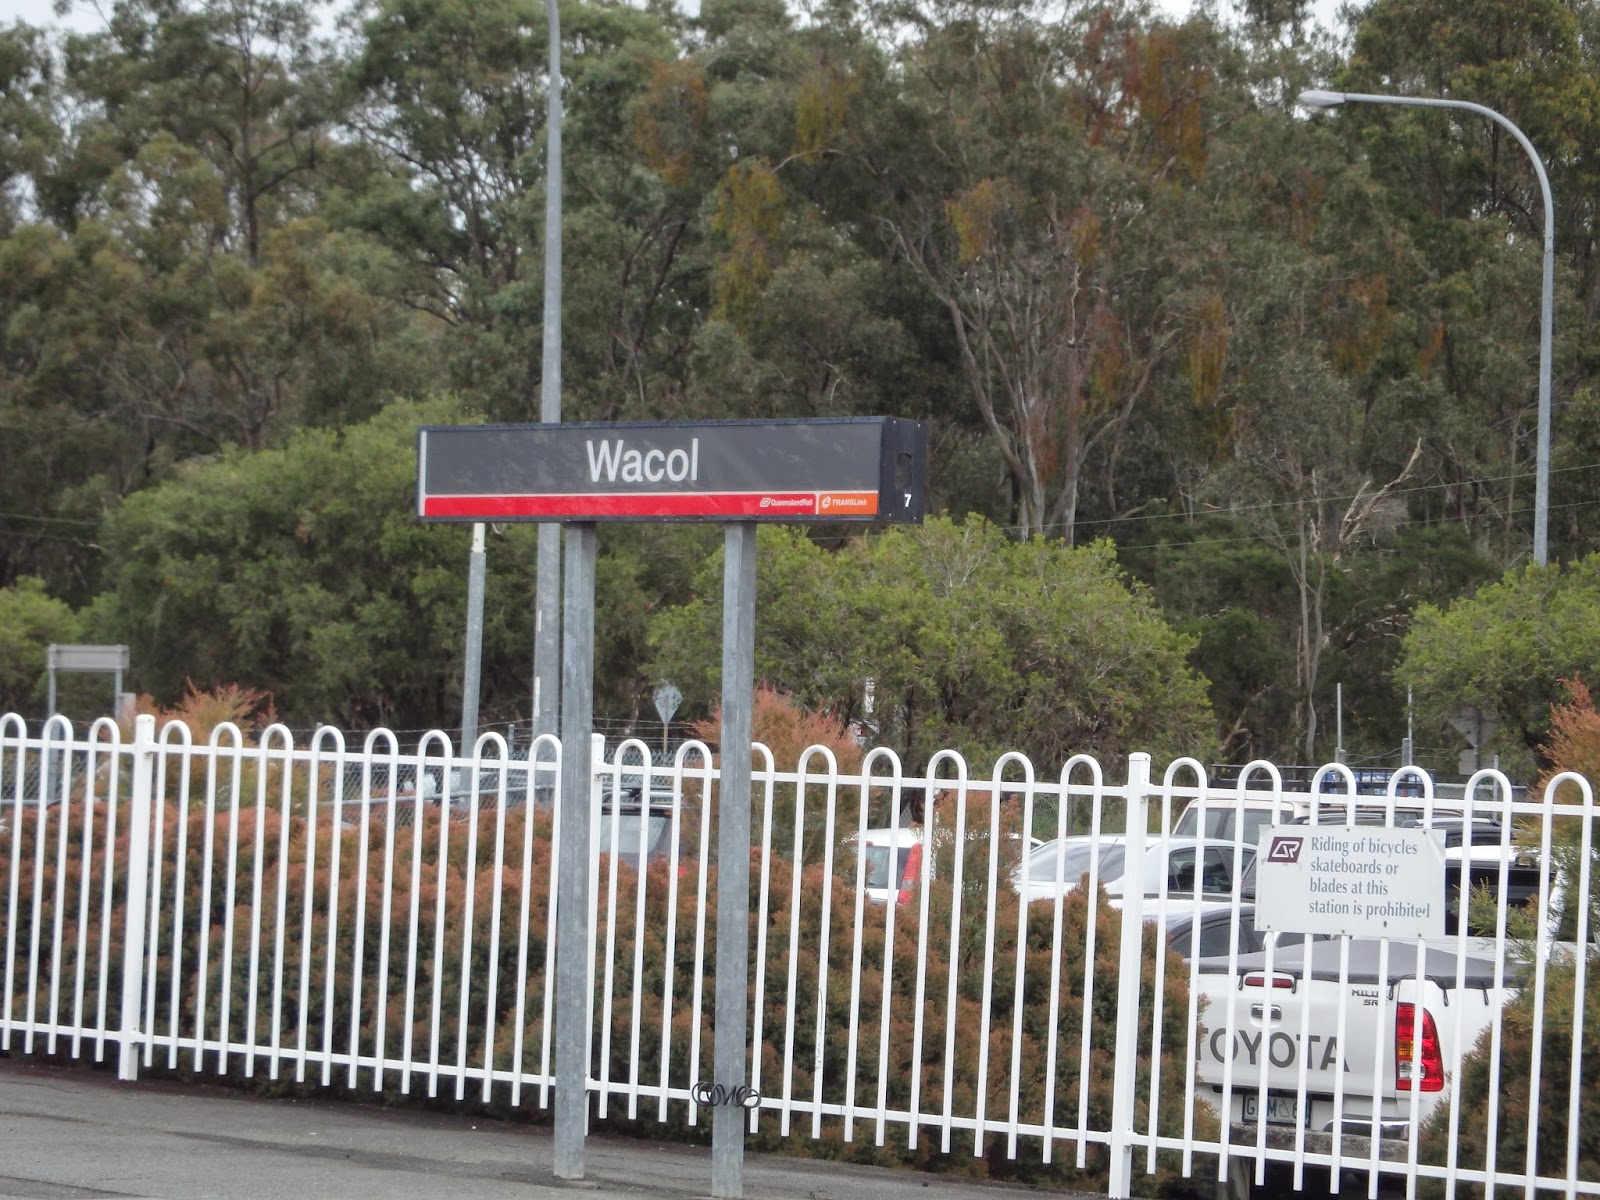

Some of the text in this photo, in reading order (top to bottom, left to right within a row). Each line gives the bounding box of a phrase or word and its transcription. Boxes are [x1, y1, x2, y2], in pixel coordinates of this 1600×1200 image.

[586, 437, 699, 483] Wacol
[904, 493, 912, 508] 7
[1311, 837, 1417, 857] Riding of bicycles
[1310, 857, 1399, 875] skateboards or
[1310, 878, 1388, 895] blades at this
[1309, 899, 1349, 914] station
[1353, 900, 1362, 915] is
[1195, 1027, 1350, 1072] TOYOTA
